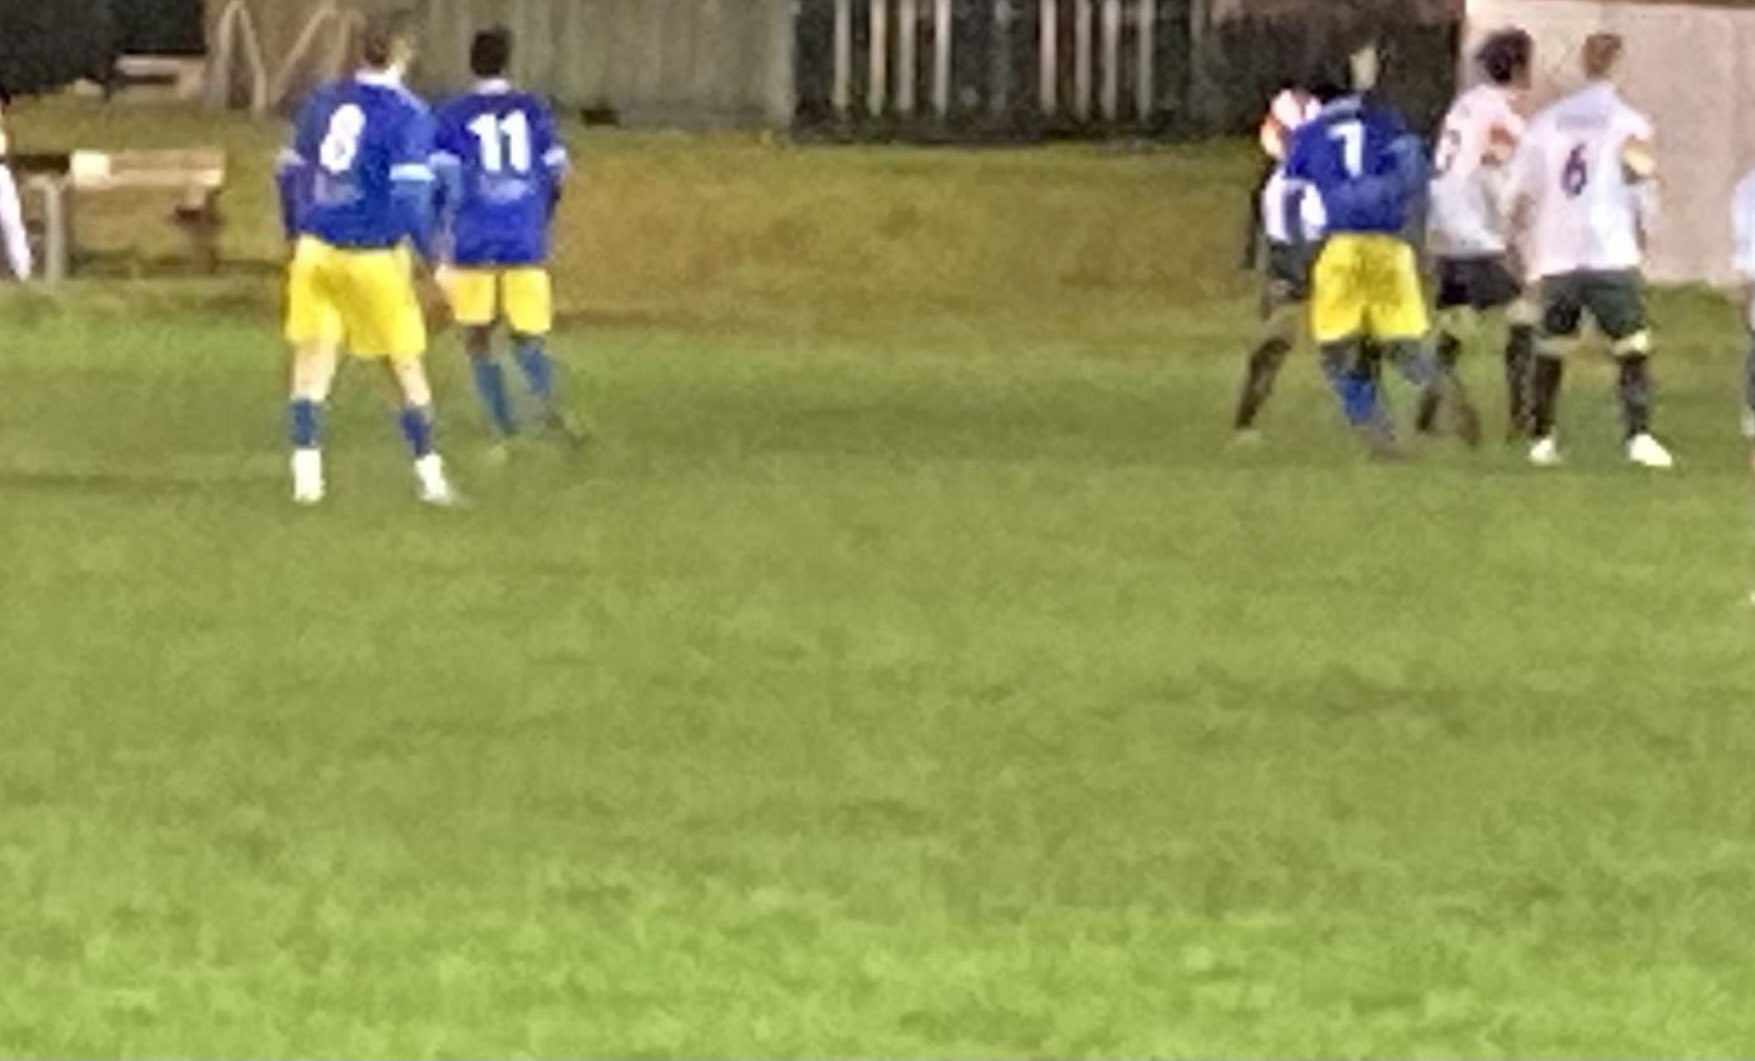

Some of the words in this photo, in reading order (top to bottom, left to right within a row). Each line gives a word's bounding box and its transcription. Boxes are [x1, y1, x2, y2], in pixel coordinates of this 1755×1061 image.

[319, 102, 366, 174] 8
[467, 110, 531, 173] 11
[1562, 143, 1587, 195] 6
